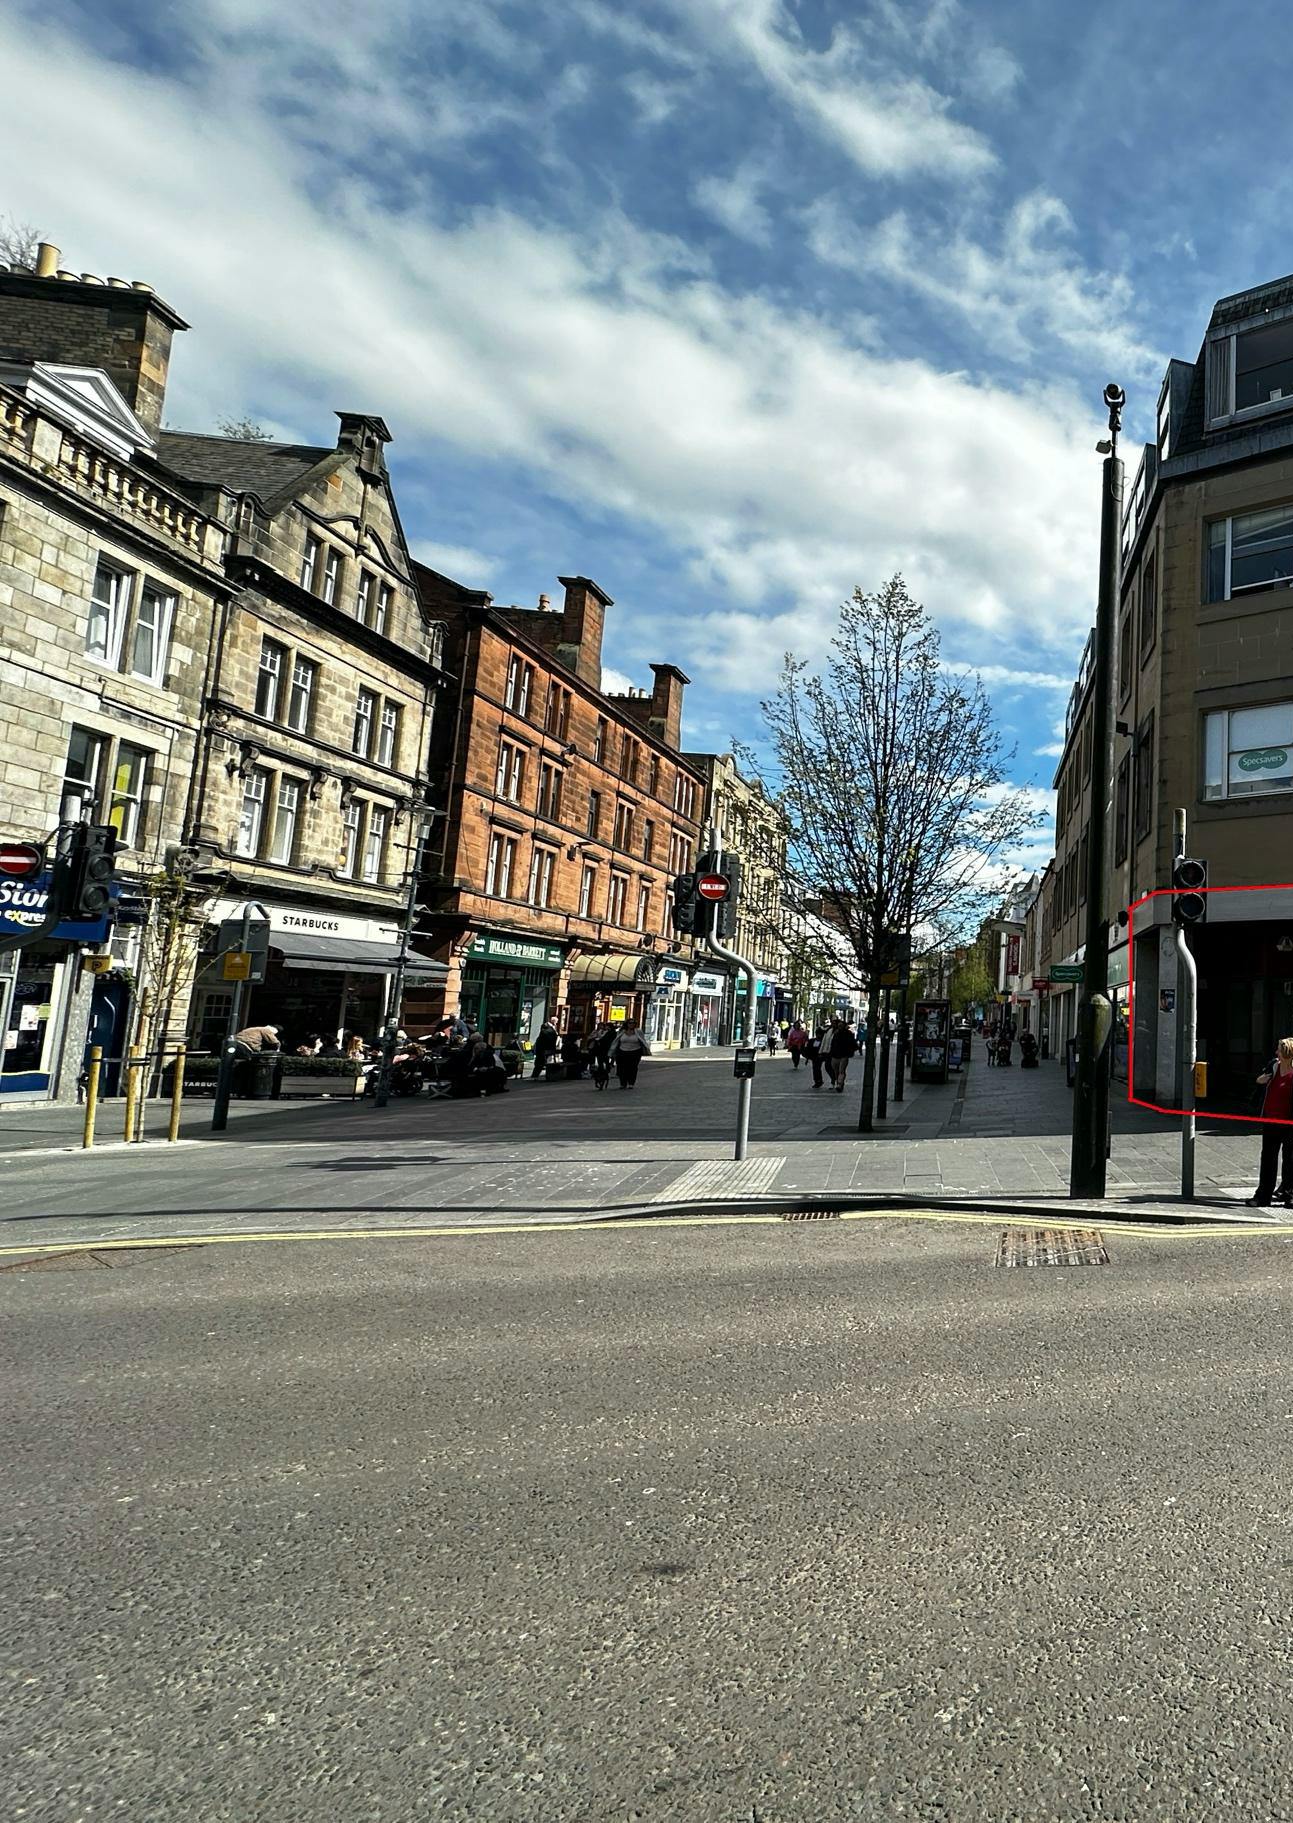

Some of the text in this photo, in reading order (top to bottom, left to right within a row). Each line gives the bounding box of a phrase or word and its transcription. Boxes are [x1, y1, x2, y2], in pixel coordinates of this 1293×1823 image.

[1242, 754, 1283, 767] Specsavers
[282, 915, 339, 931] STARBUCKS
[489, 940, 515, 954] HOLLAND
[522, 945, 546, 960] BARRETT
